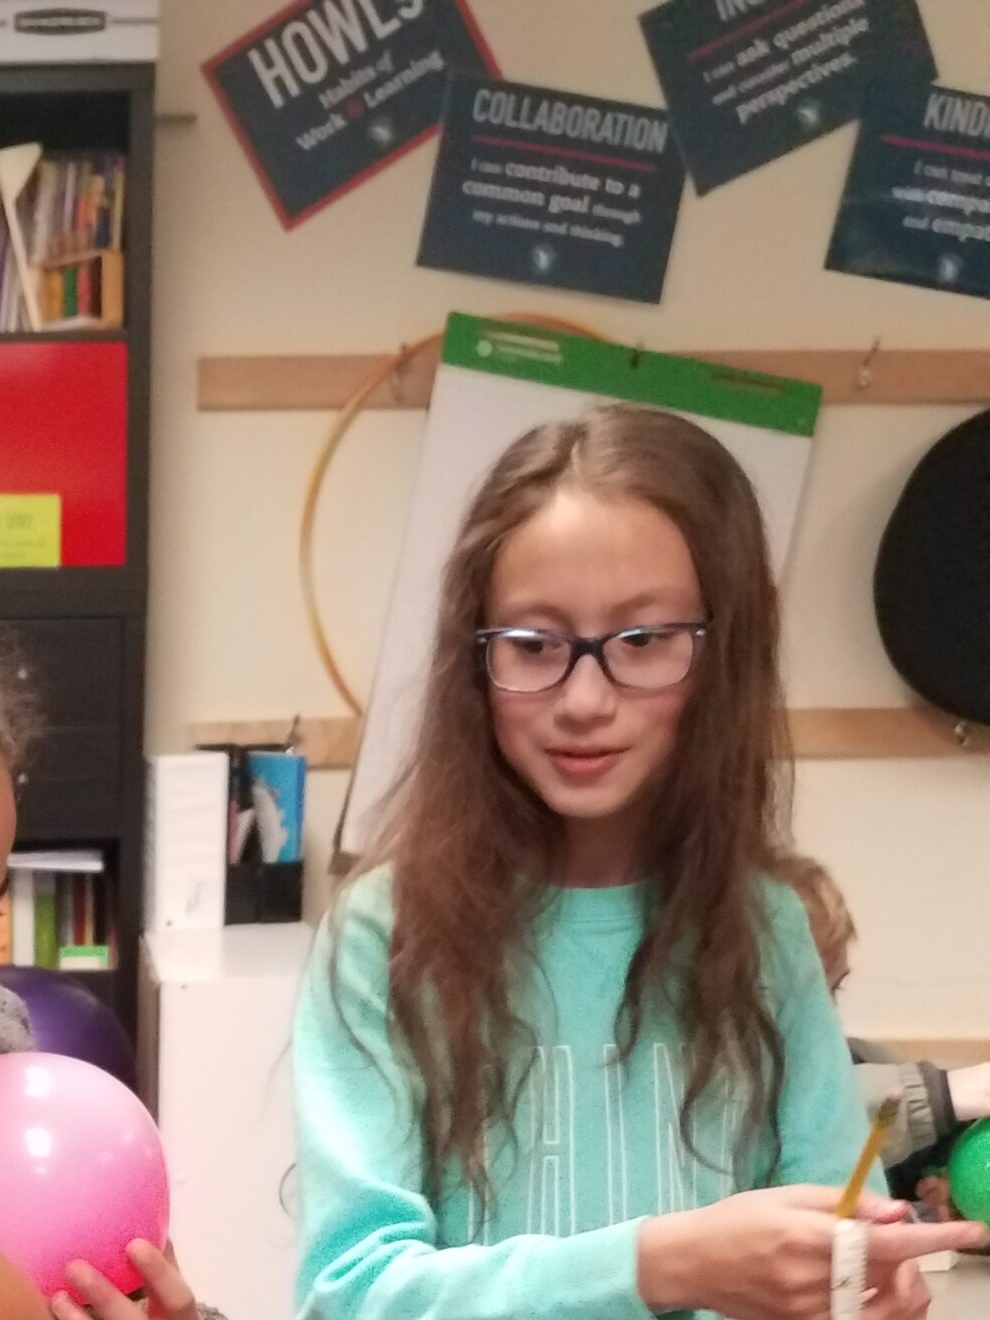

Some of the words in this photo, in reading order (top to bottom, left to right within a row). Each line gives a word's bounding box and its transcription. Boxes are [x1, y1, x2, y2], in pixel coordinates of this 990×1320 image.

[472, 89, 670, 153] COLLABORATION
[462, 180, 546, 206] common
[547, 194, 591, 214] goal
[505, 162, 600, 191] contribute
[605, 177, 625, 196] to
[628, 184, 641, 199] a
